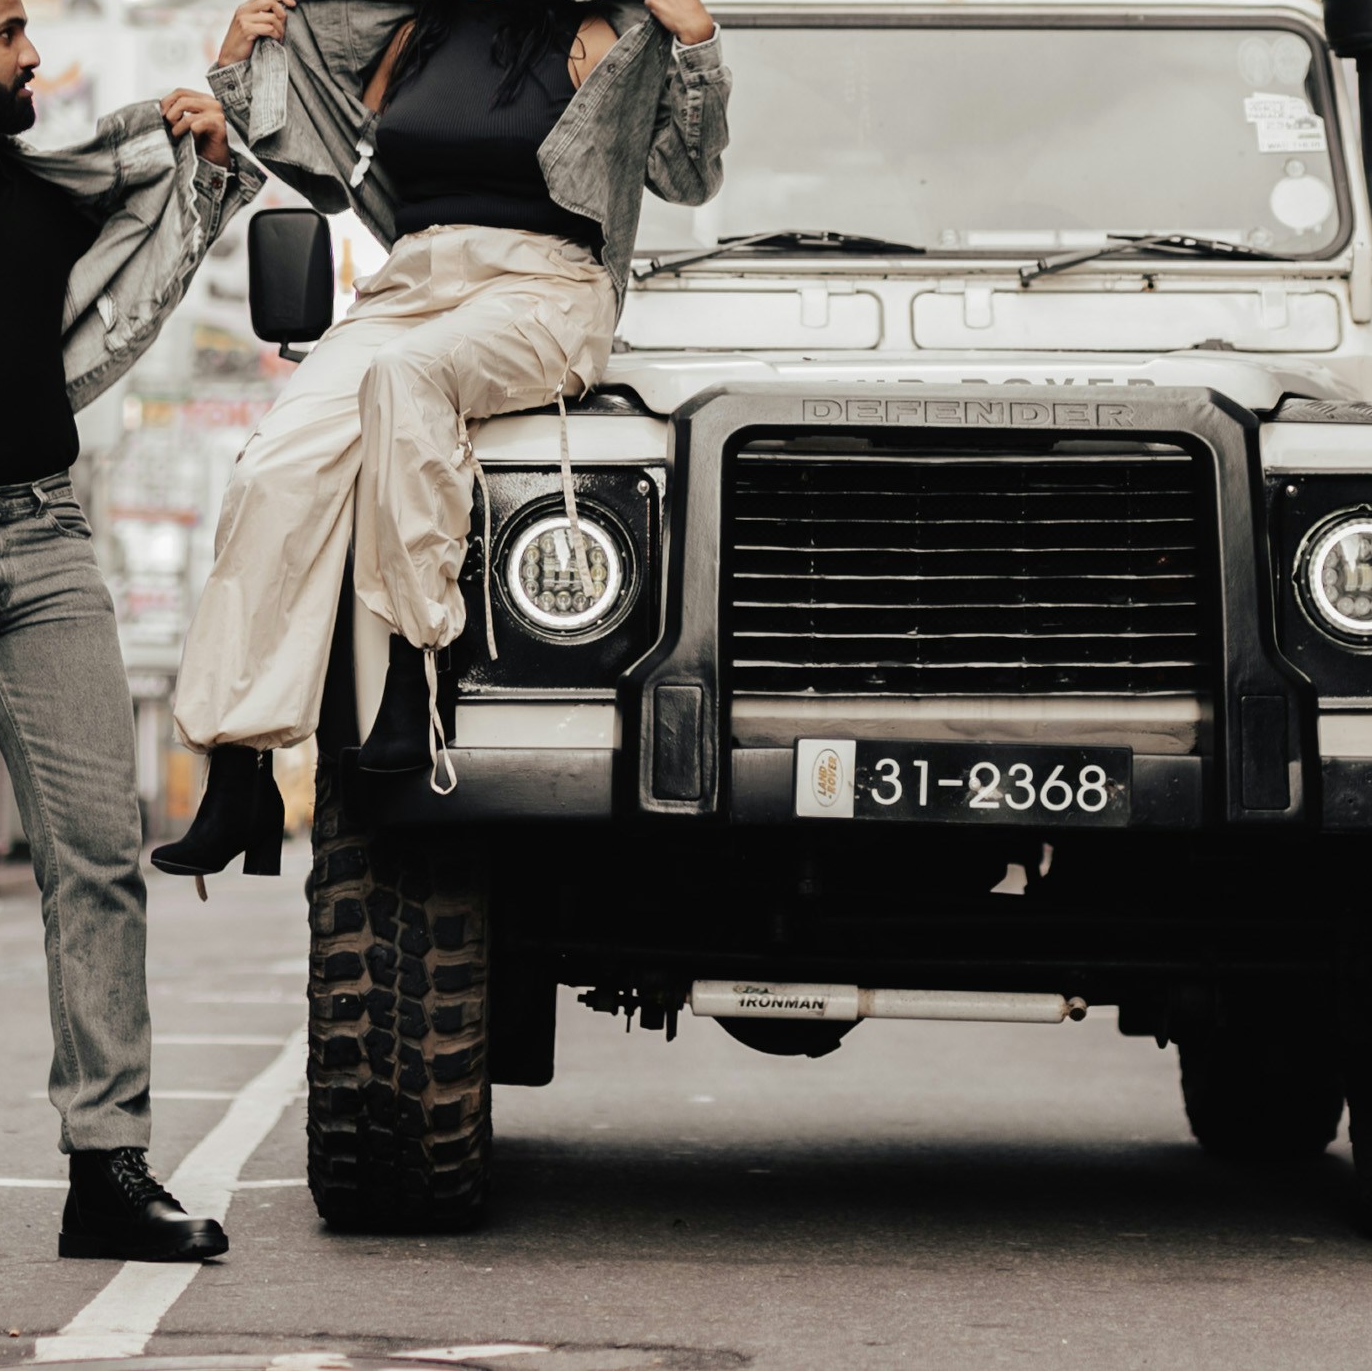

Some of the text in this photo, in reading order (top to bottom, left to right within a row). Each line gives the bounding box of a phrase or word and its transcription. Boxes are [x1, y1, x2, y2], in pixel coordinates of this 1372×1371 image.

[801, 398, 1136, 428] DEFENDER
[870, 757, 1110, 813] 31-2368
[738, 997, 825, 1011] IRONMAN
